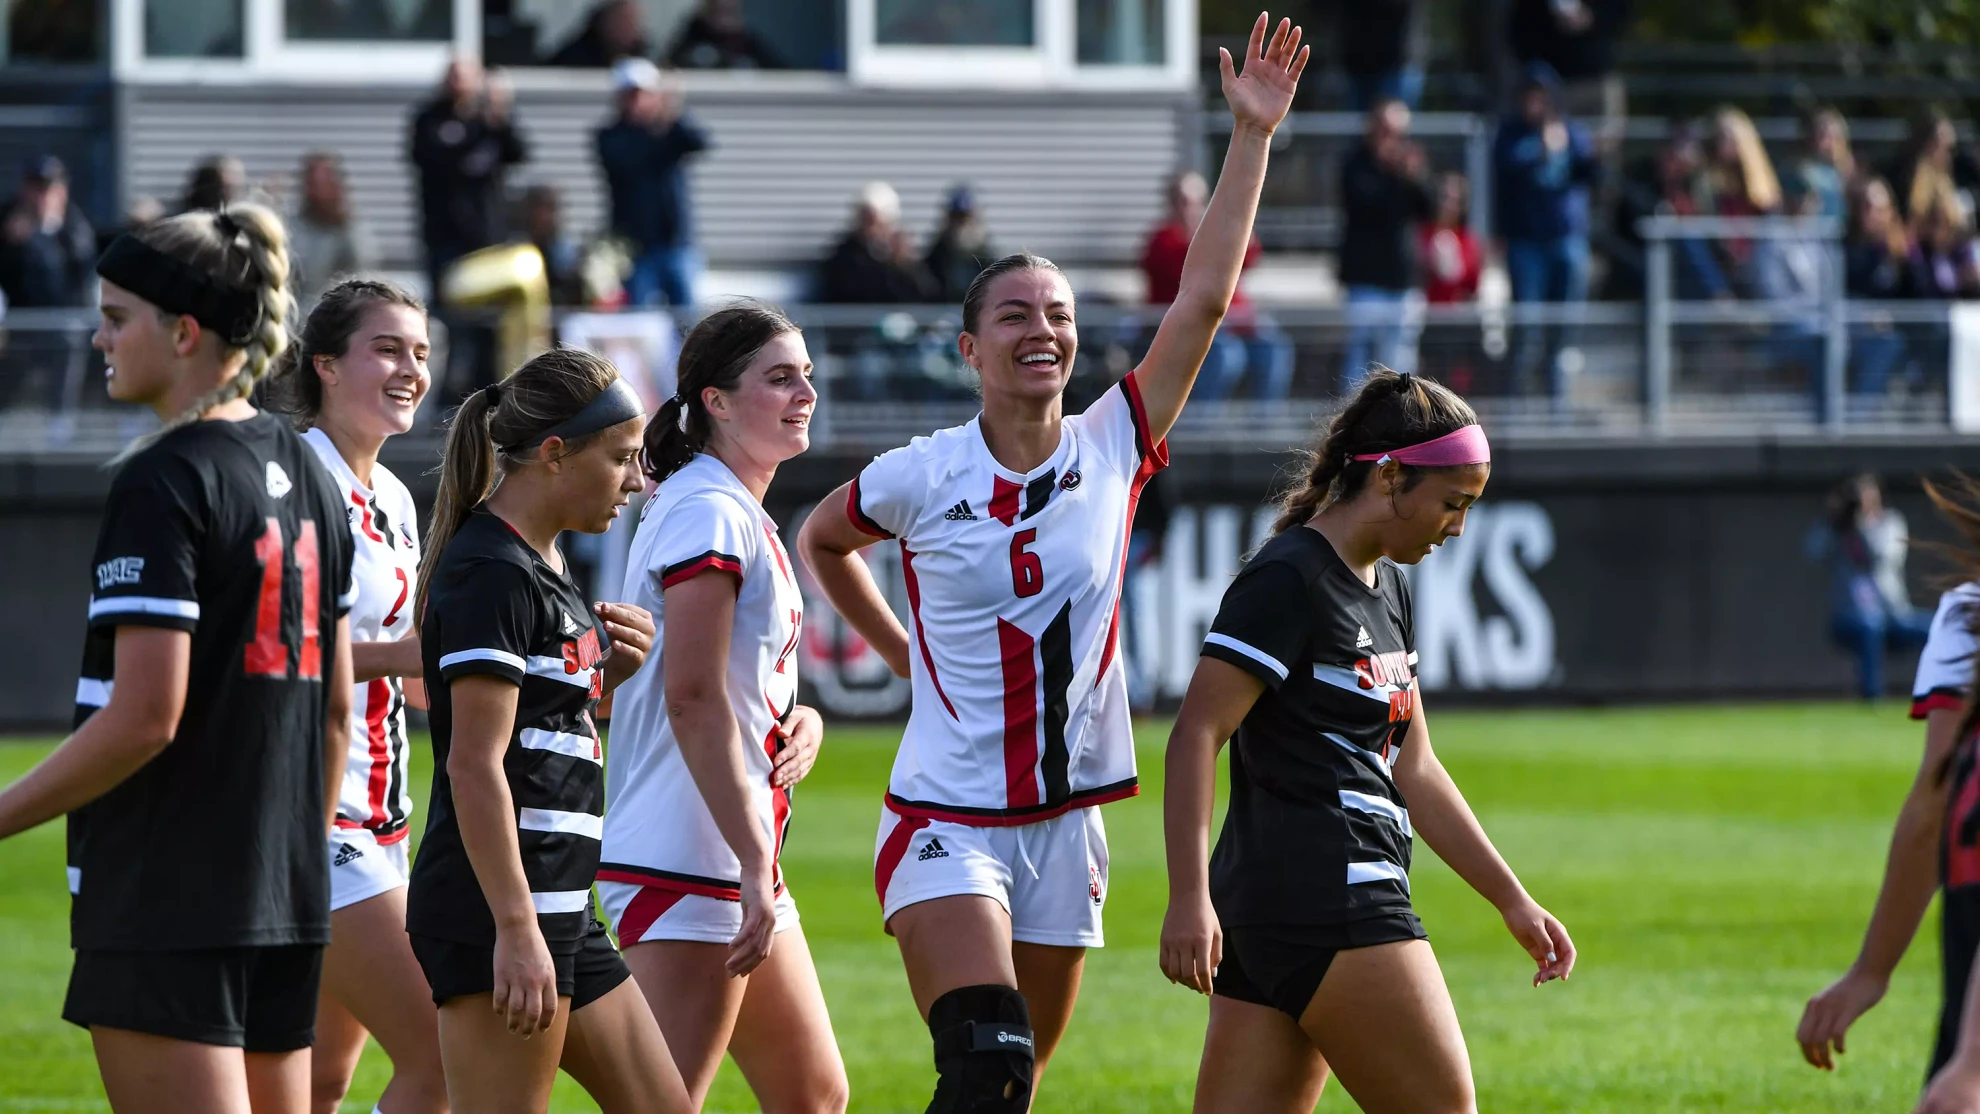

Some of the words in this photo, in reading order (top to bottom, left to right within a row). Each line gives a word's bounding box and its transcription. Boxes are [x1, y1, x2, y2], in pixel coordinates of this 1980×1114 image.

[944, 512, 978, 521] adidas
[1010, 527, 1044, 598] 6
[245, 517, 322, 681] 11
[382, 567, 408, 627] 2
[334, 850, 364, 867] adidas
[918, 849, 949, 861] adidas
[1008, 1034, 1032, 1047] BREG
